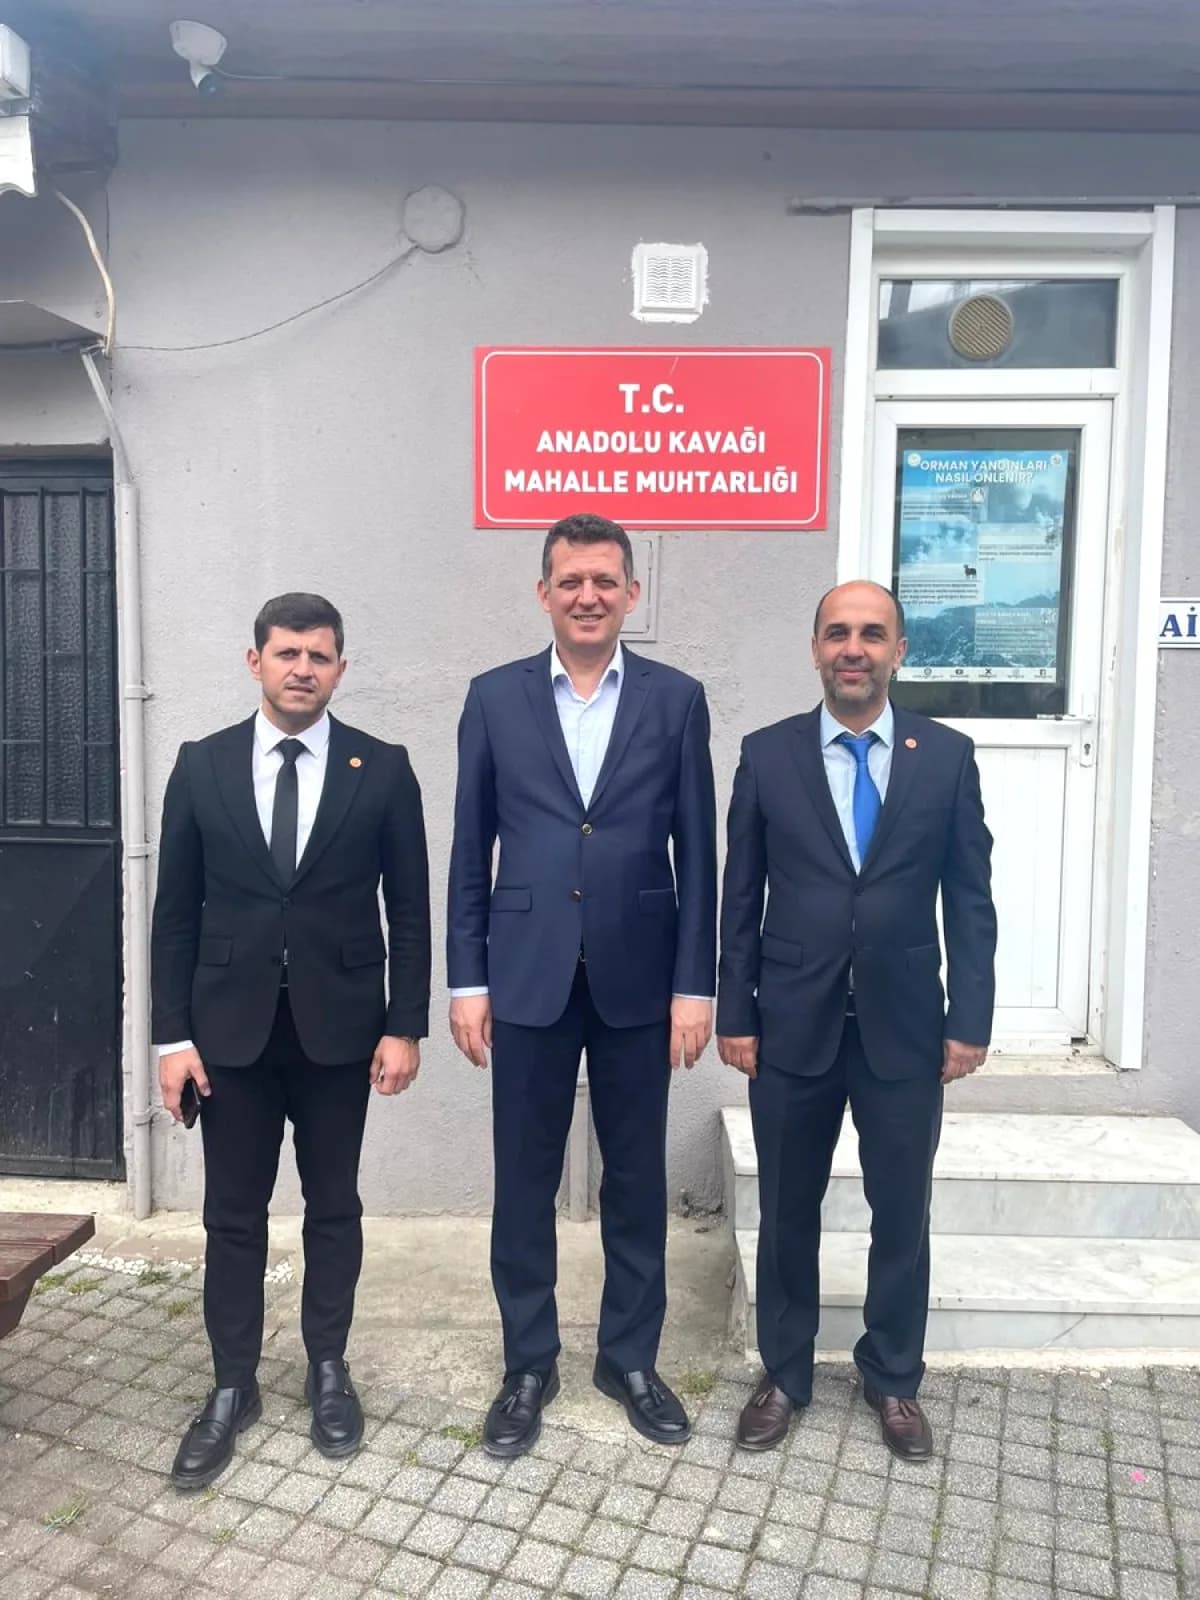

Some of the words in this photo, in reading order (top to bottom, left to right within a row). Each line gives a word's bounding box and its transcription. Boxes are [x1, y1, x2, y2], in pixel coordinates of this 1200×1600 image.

[618, 383, 685, 414] T.C.
[536, 431, 661, 454] ANADOLU
[669, 426, 766, 454] KAVAĞI
[920, 460, 968, 471] ORMAN
[935, 471, 971, 483] NASIL
[504, 470, 629, 493] MAHALLE
[636, 466, 798, 493] MUHTARLIĞI
